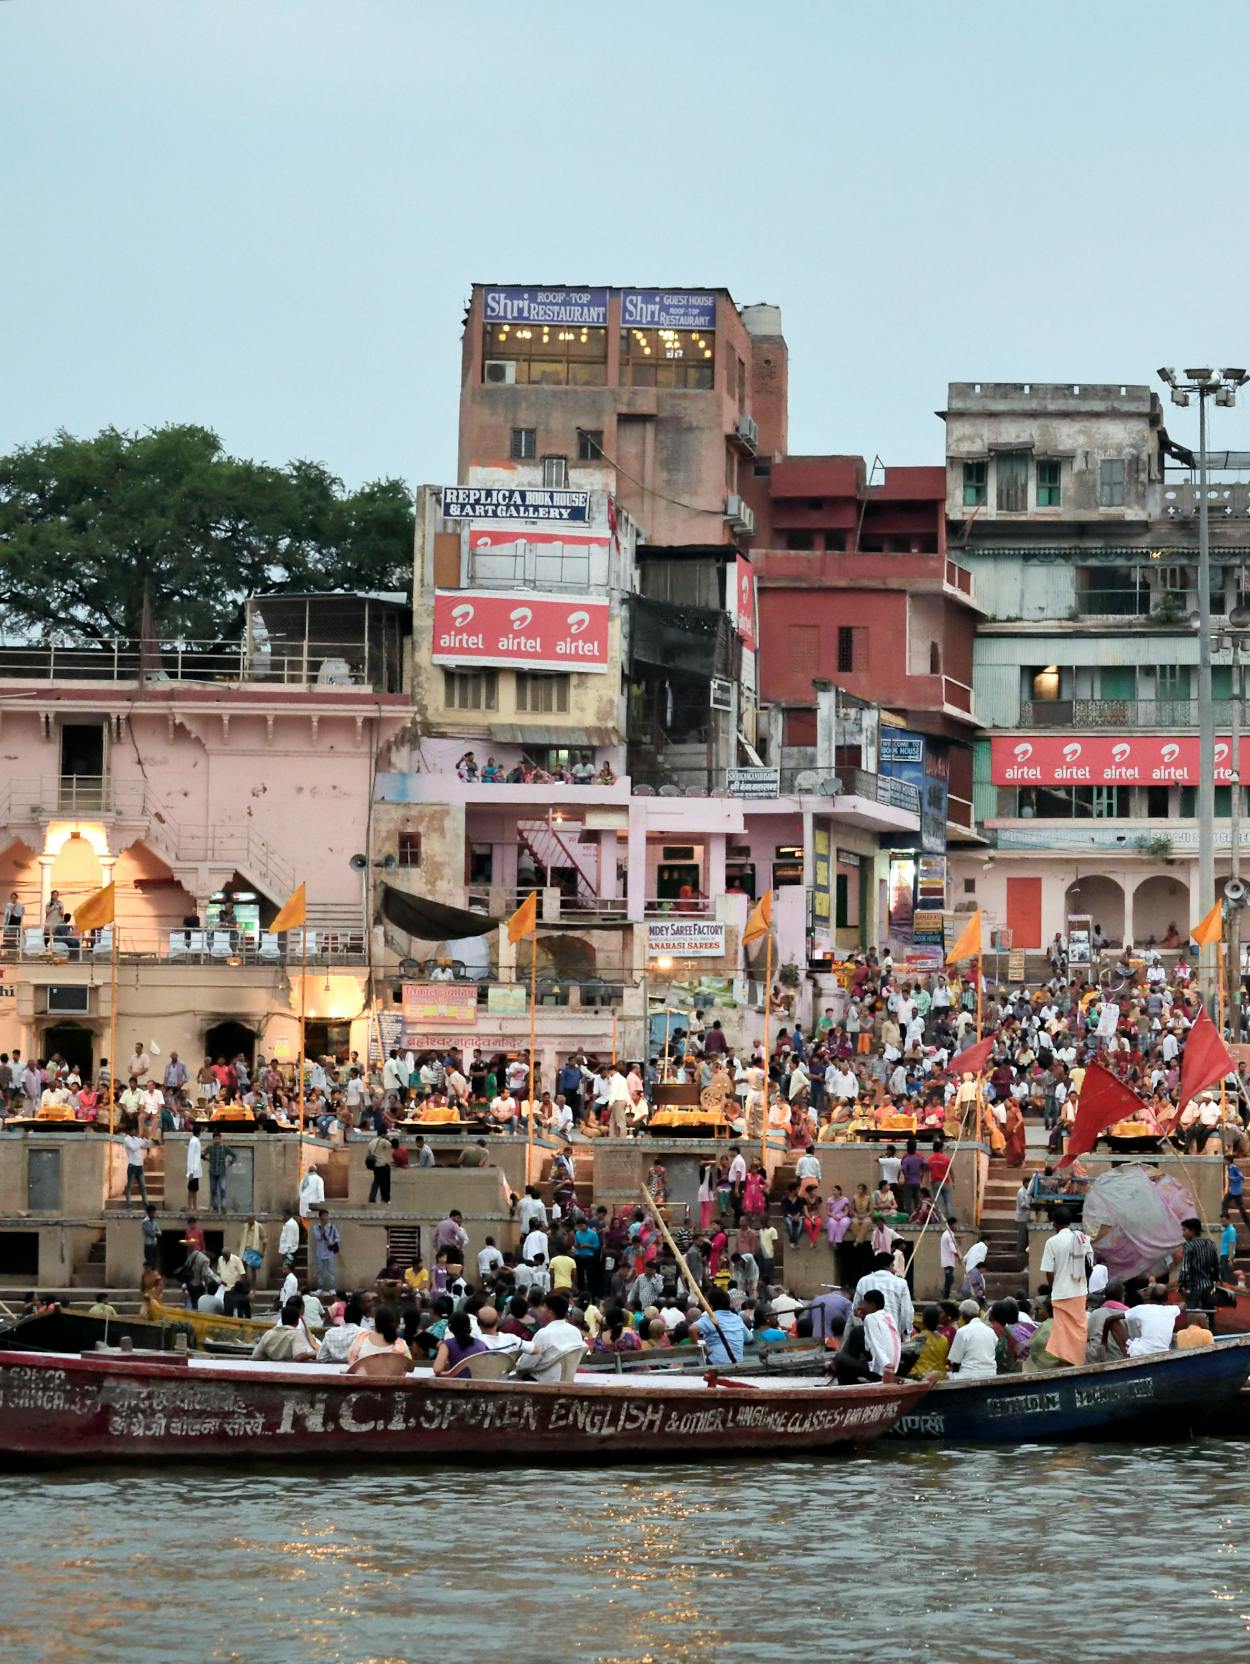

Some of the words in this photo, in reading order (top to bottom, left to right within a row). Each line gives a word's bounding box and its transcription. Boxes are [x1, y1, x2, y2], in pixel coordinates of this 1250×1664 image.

[486, 293, 529, 319] Shri
[537, 292, 591, 304] ROOF-TOP
[663, 294, 687, 305] GUEST
[688, 295, 714, 306] HOUSE
[529, 305, 606, 323] RESTAURANT
[625, 295, 659, 323] Shri
[660, 312, 710, 326] RESTAURANT
[445, 488, 523, 505] REPLICA
[525, 491, 552, 506] BOOK
[552, 493, 587, 507] HOUSE
[497, 505, 572, 519] GALLERY
[440, 631, 484, 649] airtel
[498, 634, 541, 652] airtel
[555, 638, 599, 656] airtel
[1005, 765, 1042, 780] airtel
[1054, 765, 1091, 780] airtel
[1103, 765, 1140, 780] airtel
[1152, 765, 1189, 780] airtel
[687, 941, 720, 950] SAREES
[548, 1399, 665, 1435] ENGLISH
